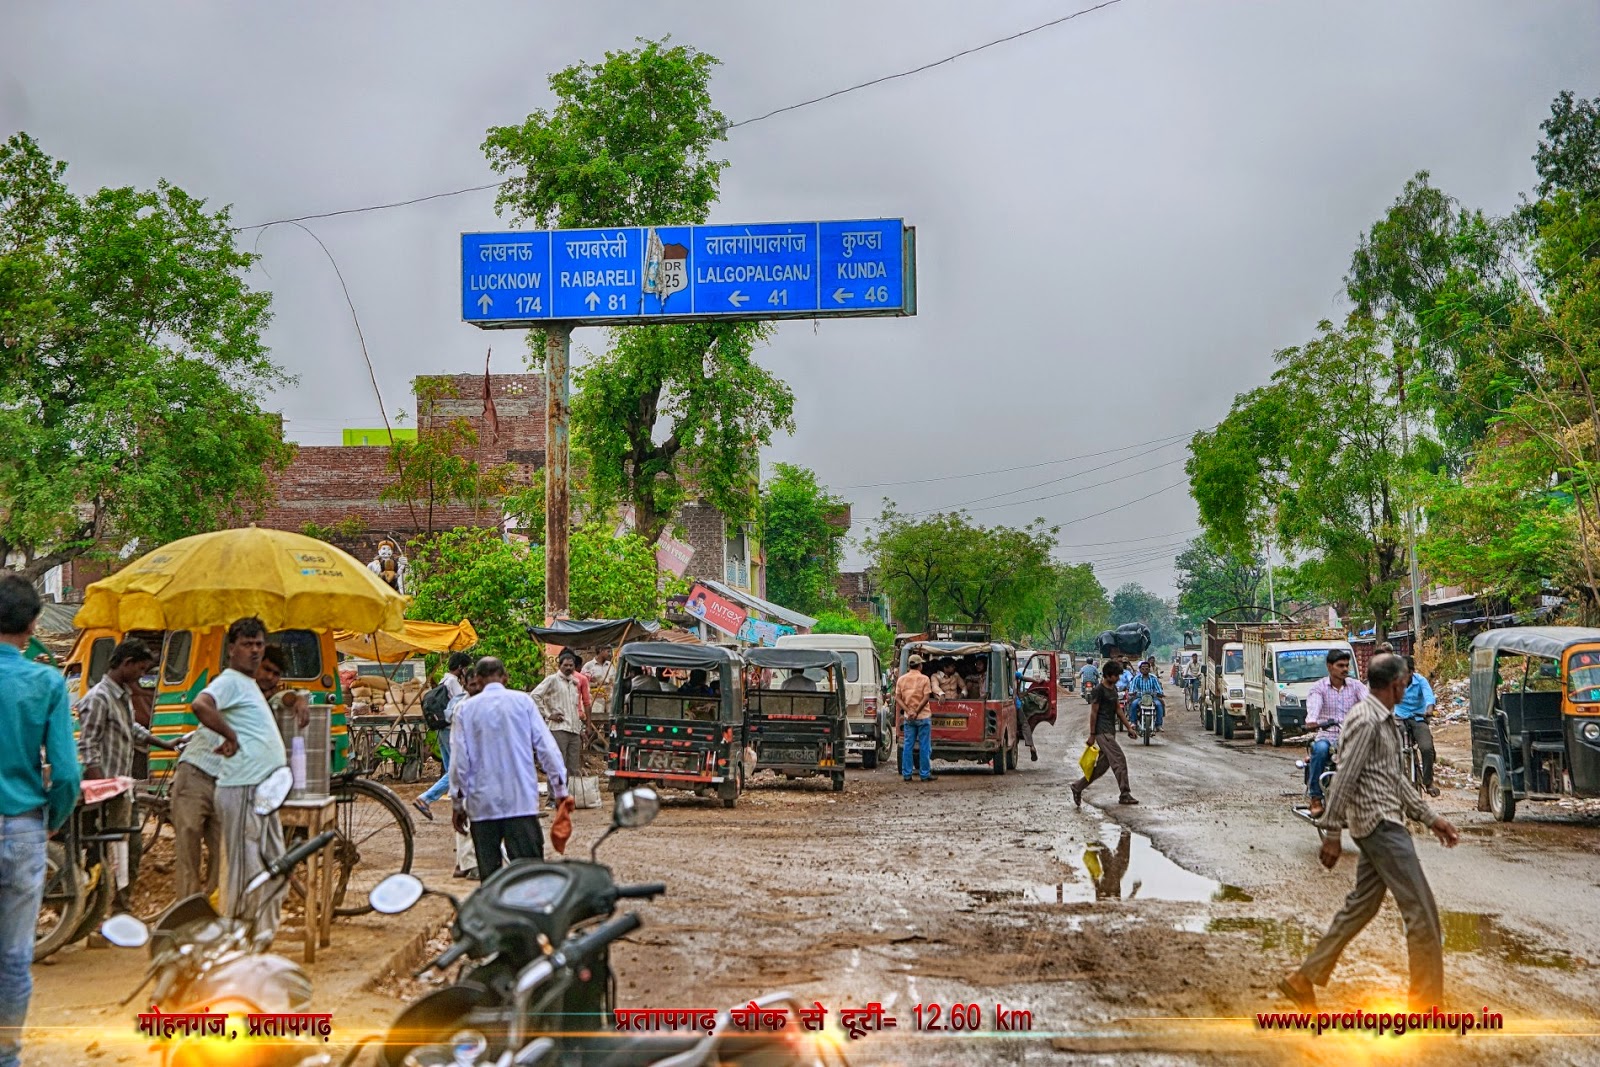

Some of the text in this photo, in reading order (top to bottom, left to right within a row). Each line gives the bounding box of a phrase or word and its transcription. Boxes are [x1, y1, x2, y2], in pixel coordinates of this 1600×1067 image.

[566, 232, 627, 259] रायबरेली
[705, 228, 806, 255] लालगोपालगंज
[842, 231, 882, 258] कुण्डा
[479, 243, 533, 262] लखनऊ
[560, 269, 635, 288] RAIBARELI
[697, 264, 810, 283] LALGOPALGANJ
[837, 261, 887, 279] KUNDA
[470, 272, 541, 290] LUCKNOW
[608, 294, 626, 311] 81
[767, 288, 788, 306] 41
[864, 285, 889, 302] 46
[515, 296, 542, 313] 174
